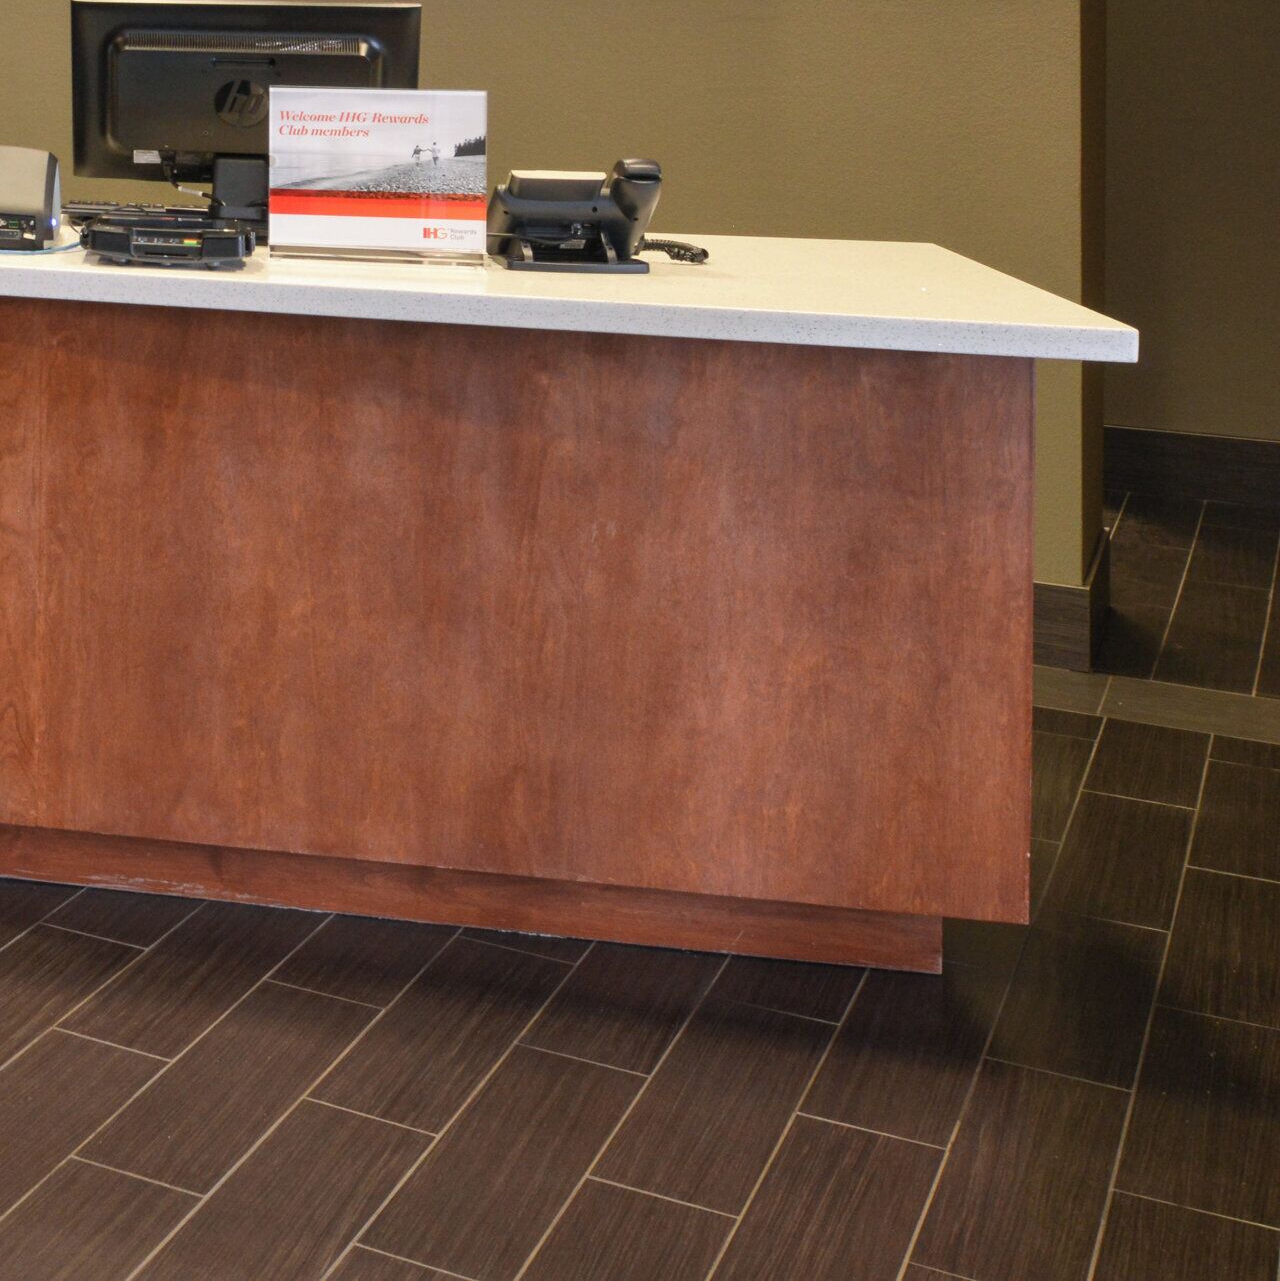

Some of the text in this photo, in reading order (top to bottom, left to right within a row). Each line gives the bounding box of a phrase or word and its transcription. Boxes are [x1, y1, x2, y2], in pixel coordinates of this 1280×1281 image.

[278, 110, 429, 125] Welcome IHG Rewards
[278, 125, 370, 137] Club members
[422, 227, 447, 240] IHG
